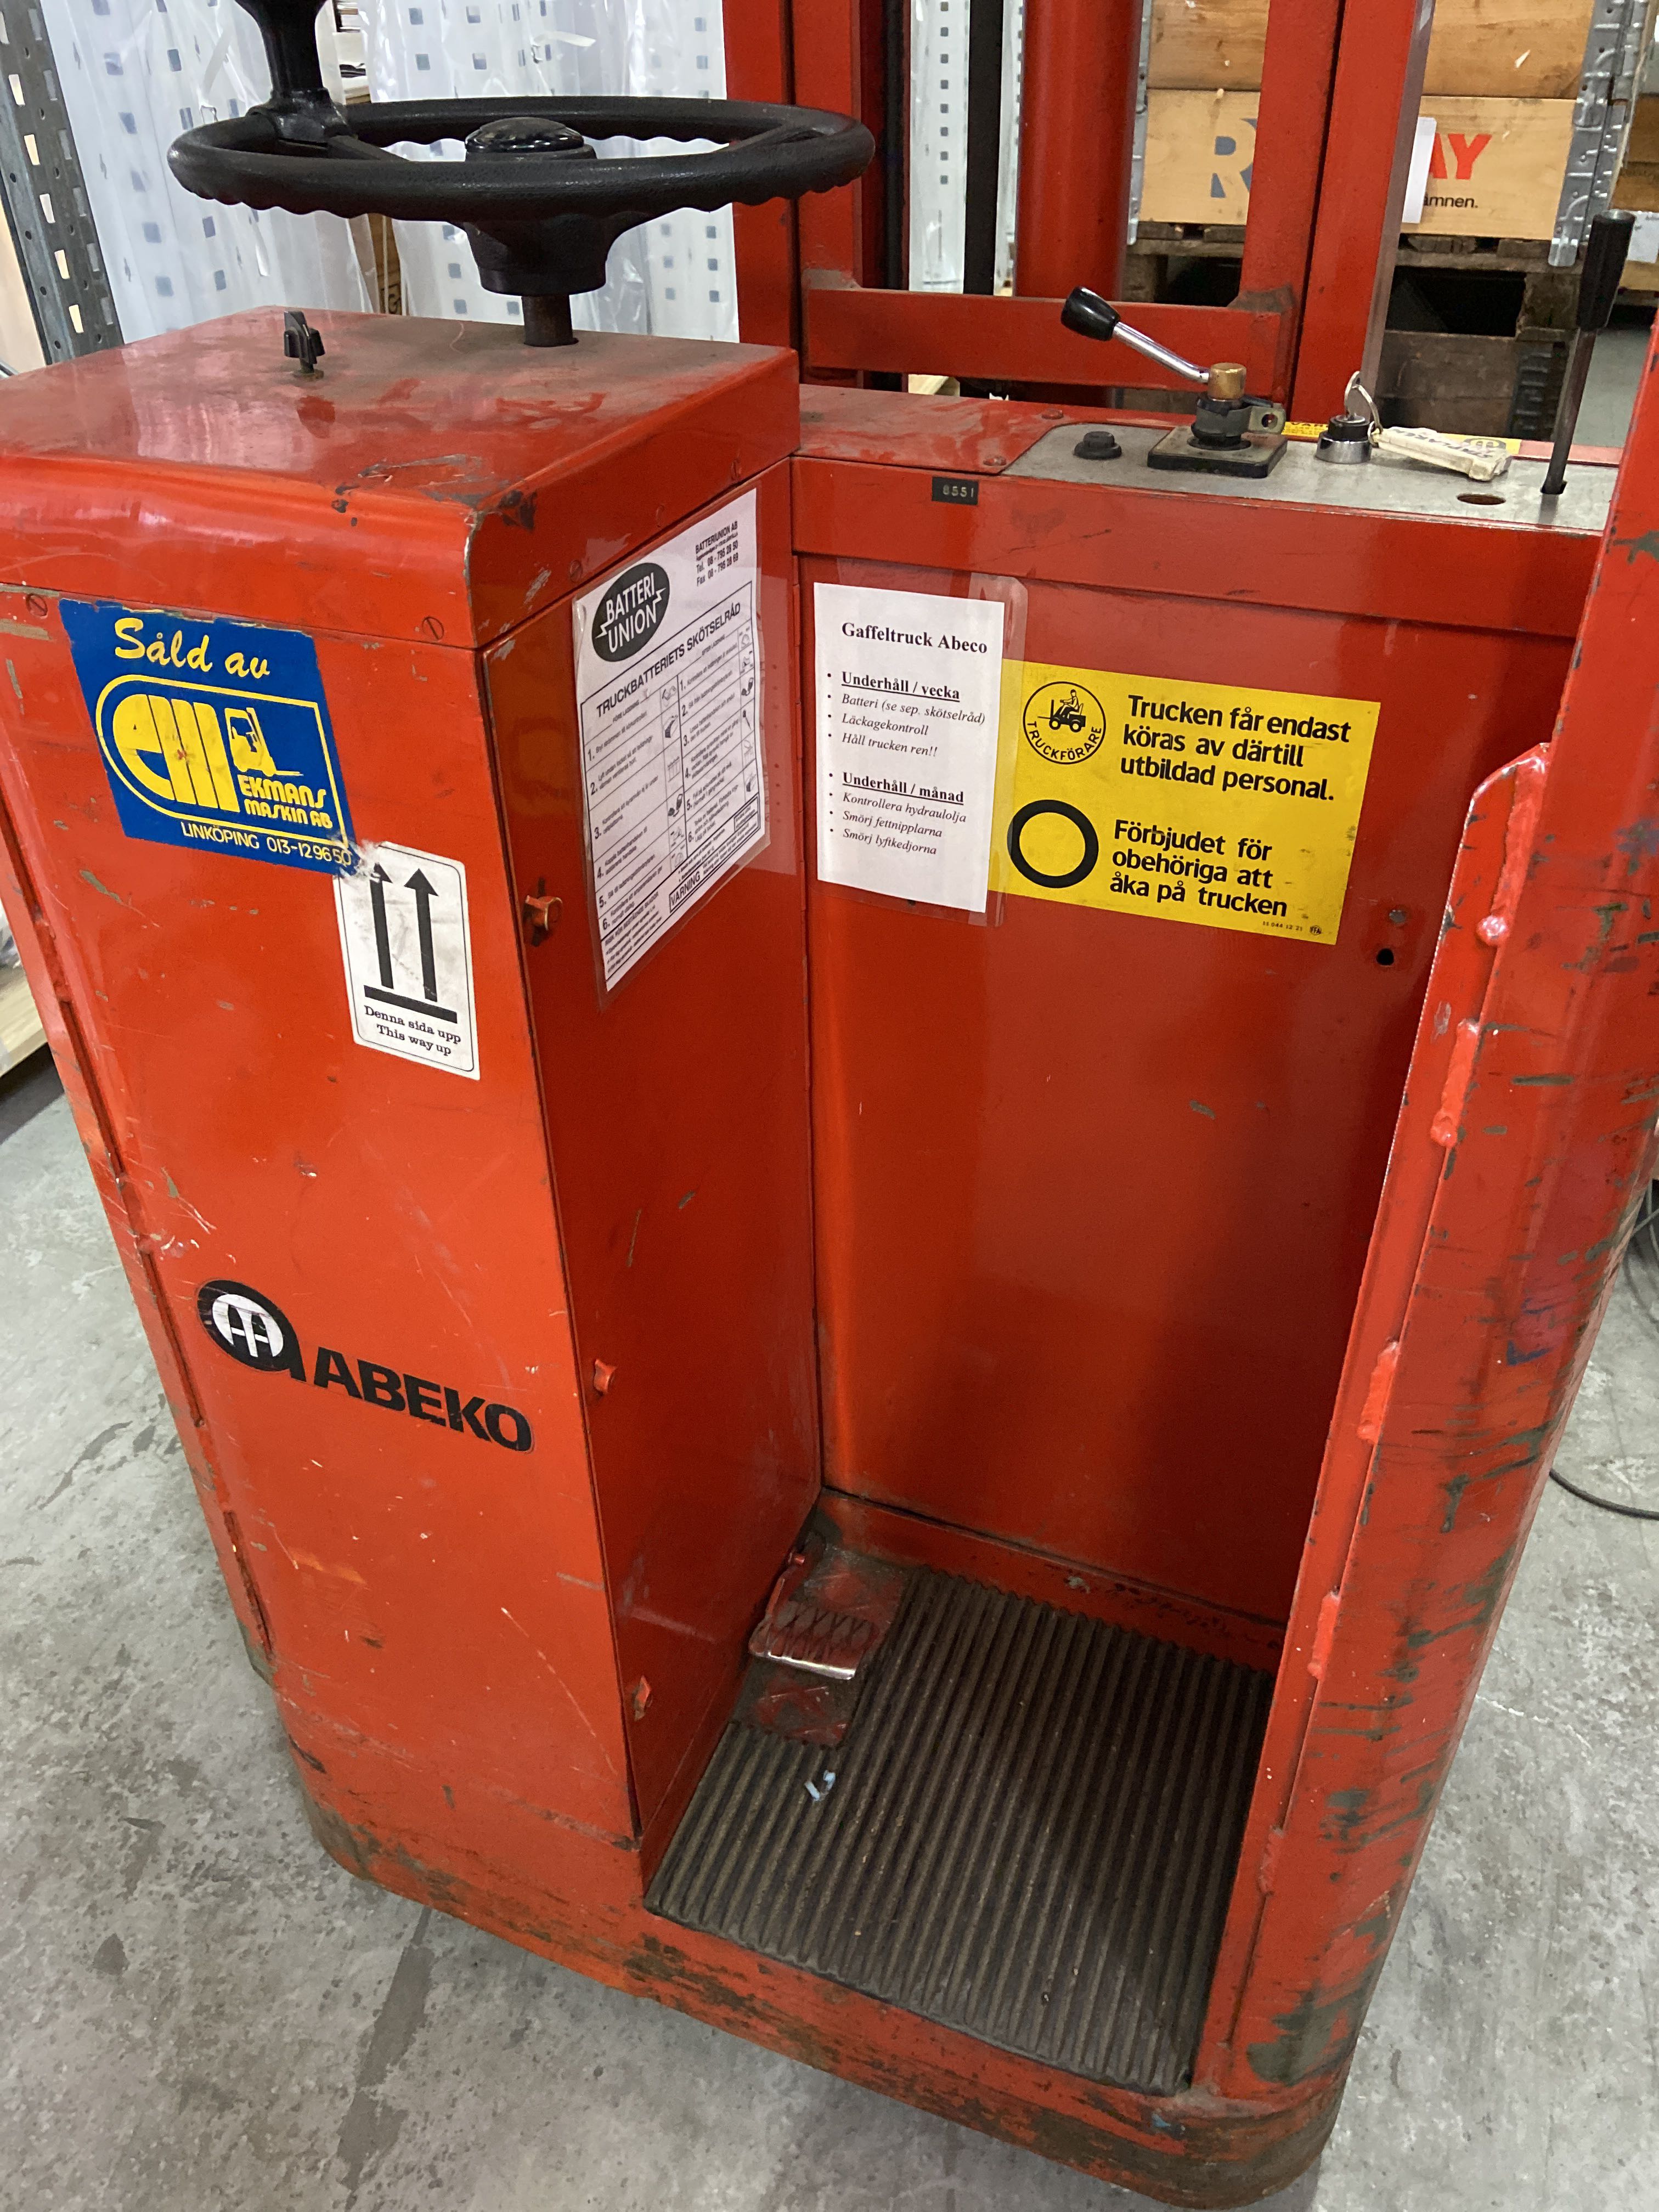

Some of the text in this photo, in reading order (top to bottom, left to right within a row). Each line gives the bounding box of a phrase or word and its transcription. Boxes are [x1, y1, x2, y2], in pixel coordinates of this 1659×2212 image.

[695, 524, 730, 554] BATTERIUNION
[731, 521, 737, 532] AB
[696, 561, 704, 573] Tel.
[697, 573, 705, 586] Fax
[606, 572, 654, 624] BATTERI
[608, 602, 657, 653] UNION
[842, 622, 988, 653] Gaffeltruck Abeco
[114, 617, 271, 678] Såld av
[596, 648, 685, 718] TRUCKBATTERIETS
[687, 602, 741, 653] SKÖTSELRÅD
[842, 671, 960, 699] Underhåll / vecka
[681, 702, 687, 717] 2.
[842, 693, 986, 726] Batteri (se sep. skötselråd)
[842, 713, 929, 736] Läckagekontroll
[1128, 695, 1352, 743] Trucken får endast
[683, 732, 689, 747] 3.
[842, 732, 938, 757] Håll trucken ren!!
[1026, 720, 1103, 760] TRUCKFÖRARE
[1123, 724, 1305, 767] köras av därtill
[590, 780, 597, 795] 2.
[685, 766, 690, 780] 4.
[843, 771, 964, 803] Underhåll / månad
[1120, 755, 1335, 802] utbildad personal.
[237, 774, 326, 809] EKMANS
[686, 797, 692, 811] 5.
[244, 798, 334, 829] MASKIN AB
[843, 792, 967, 823] Kontrollera hydraulolja
[182, 822, 259, 850] LINKÖPING
[594, 824, 601, 840] 3.
[688, 830, 693, 843] 6.
[843, 810, 943, 837] Smörj fettnipplarna
[843, 828, 937, 855] Smörj lyftkedjorna
[1114, 819, 1273, 861] Förbjudet för
[596, 865, 603, 881] 4.
[1112, 849, 1273, 889] obehöriga att
[599, 893, 606, 909] 5.
[671, 870, 699, 907] VARNING
[1110, 872, 1288, 917] åka på trucken
[602, 915, 610, 932] 6.
[364, 1005, 461, 1044] Denna sida upp
[376, 1023, 452, 1057] This way up
[313, 1346, 534, 1453] ABEKO
